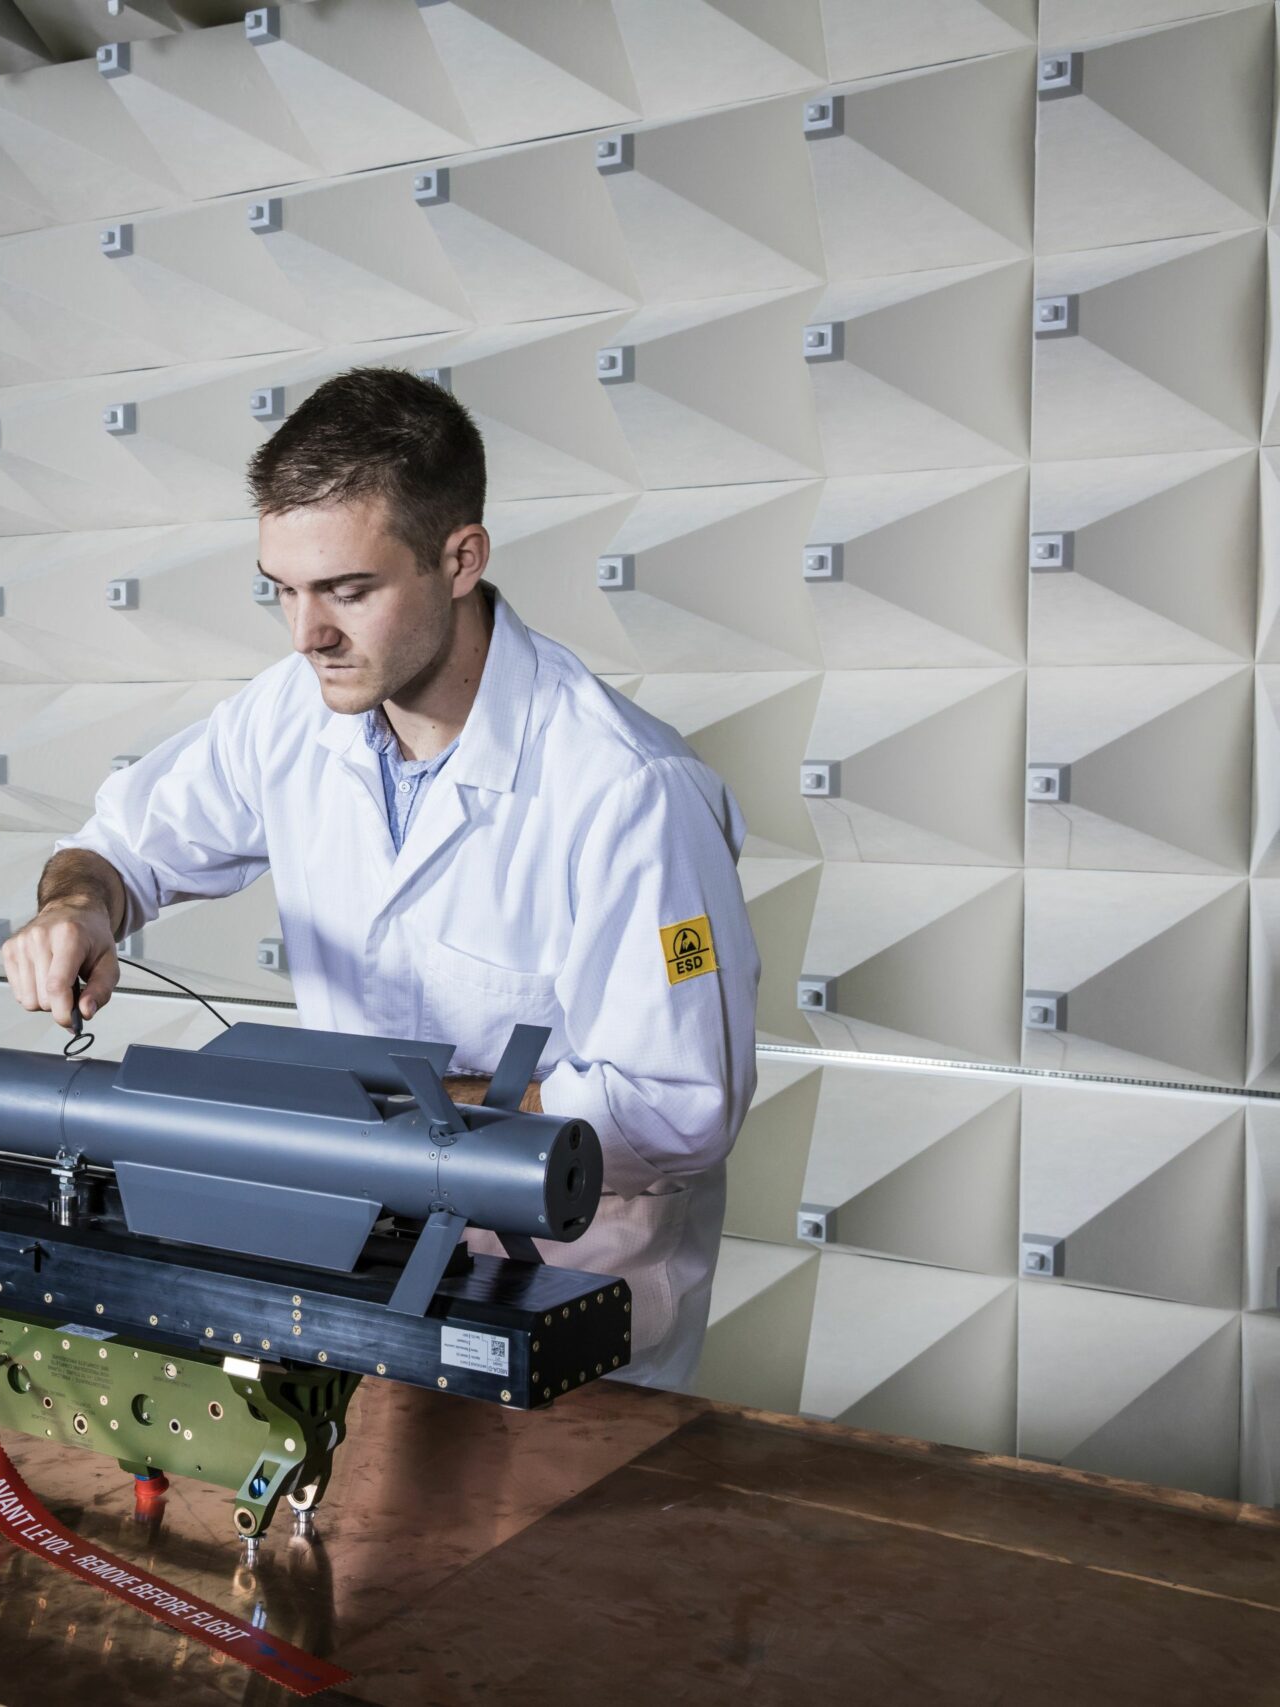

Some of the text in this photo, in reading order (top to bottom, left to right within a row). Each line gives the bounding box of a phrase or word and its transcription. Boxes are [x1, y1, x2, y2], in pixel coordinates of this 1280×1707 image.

[676, 956, 703, 975] ESD
[20, 1523, 52, 1541] LE
[39, 1534, 72, 1555] VOL
[73, 1554, 143, 1589] REMOVE
[130, 1583, 193, 1617] BEFORE
[184, 1611, 250, 1642] FLIGHT
